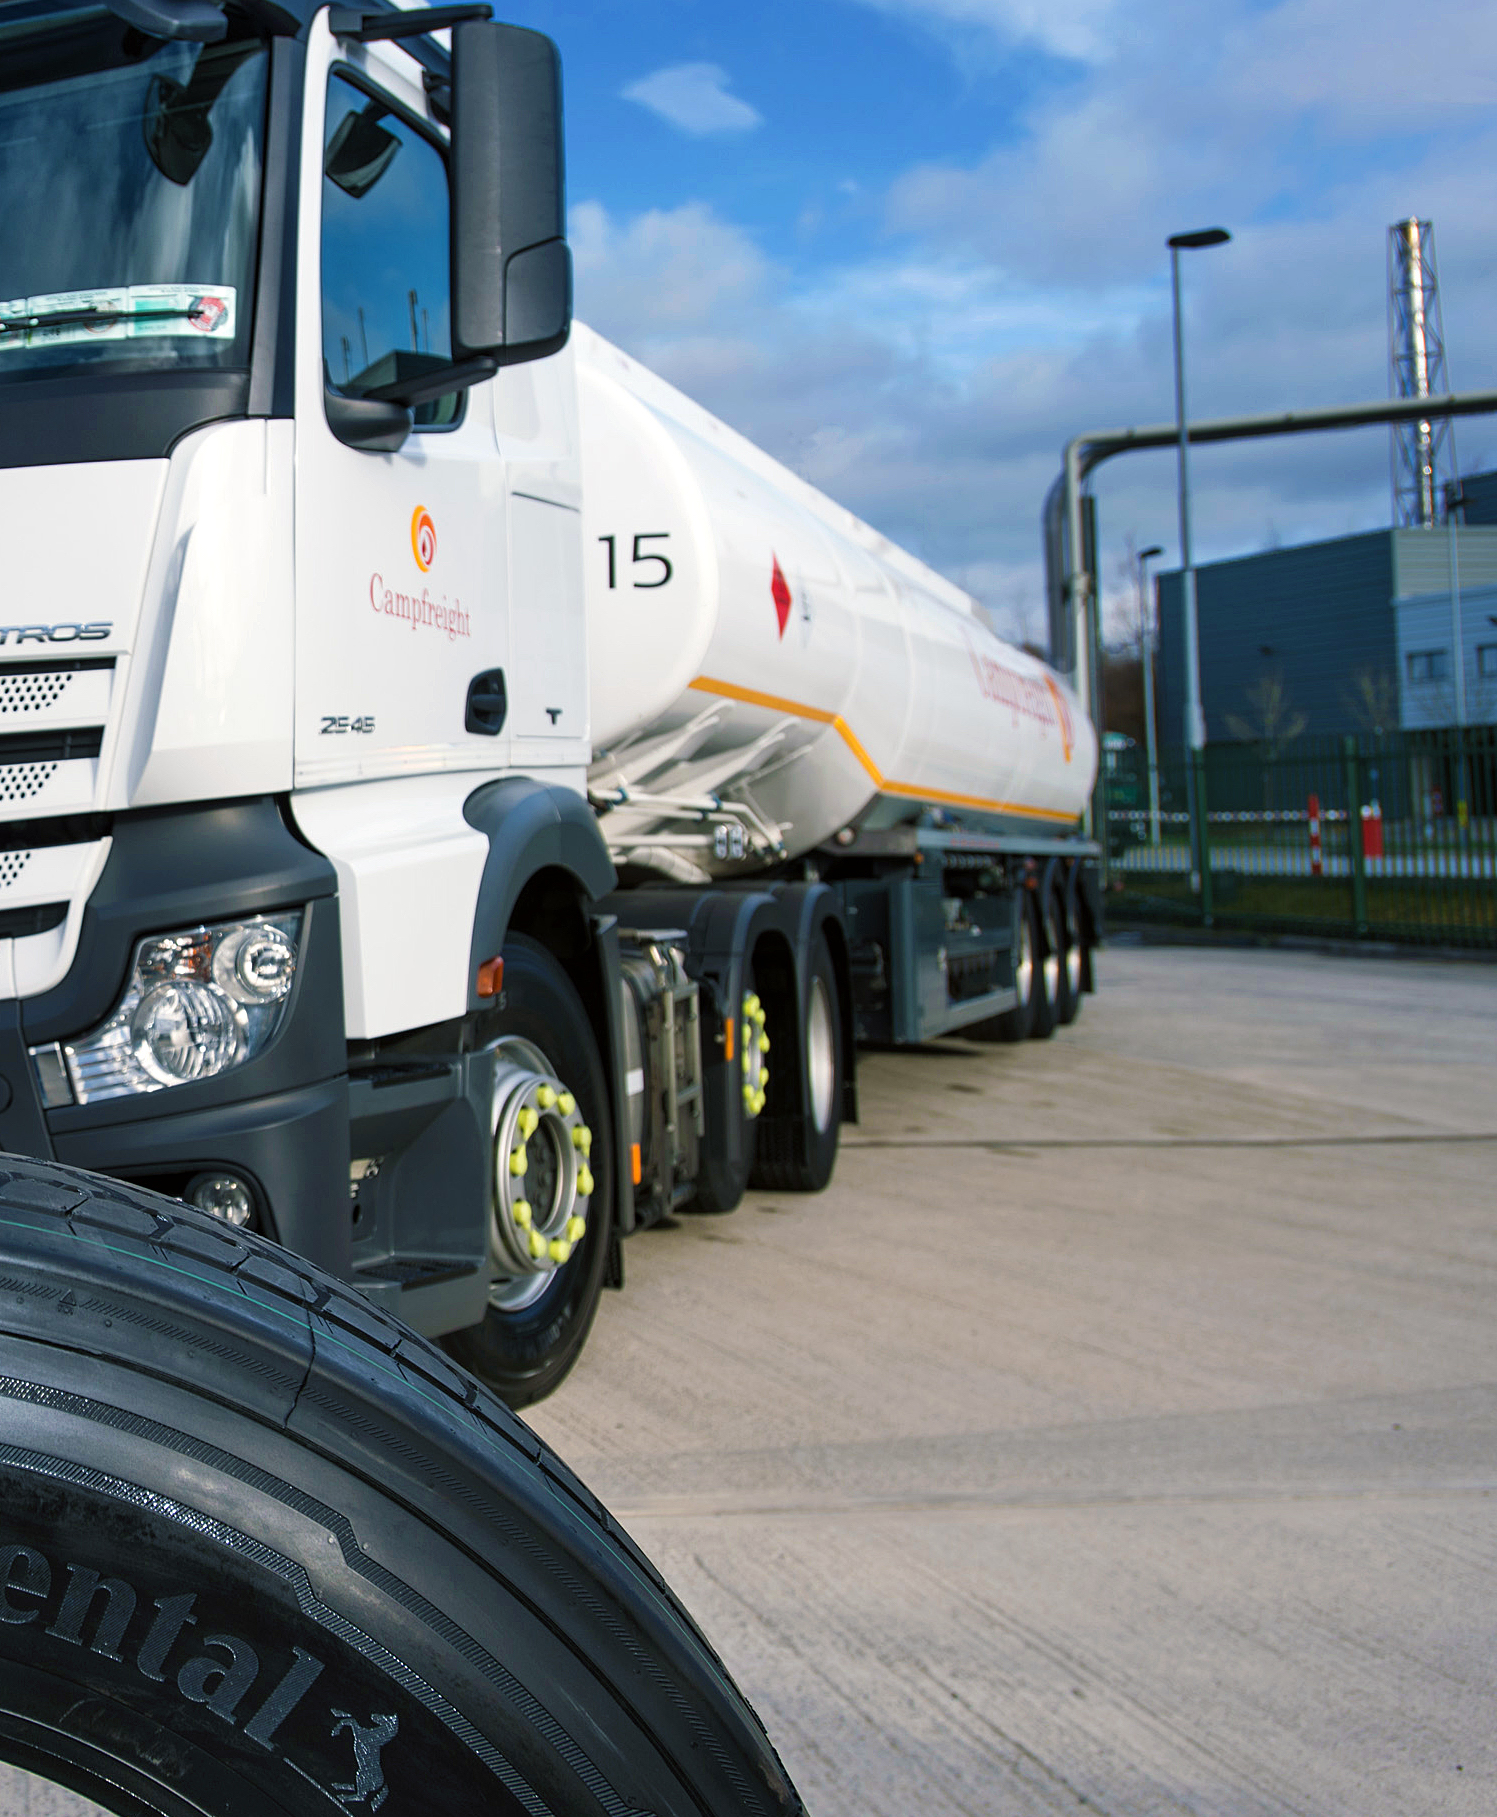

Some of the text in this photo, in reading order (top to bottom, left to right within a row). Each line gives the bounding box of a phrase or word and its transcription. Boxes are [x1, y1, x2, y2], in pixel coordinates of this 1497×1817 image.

[598, 533, 673, 588] 15
[370, 572, 471, 641] Campfreight
[319, 716, 376, 734] 2545
